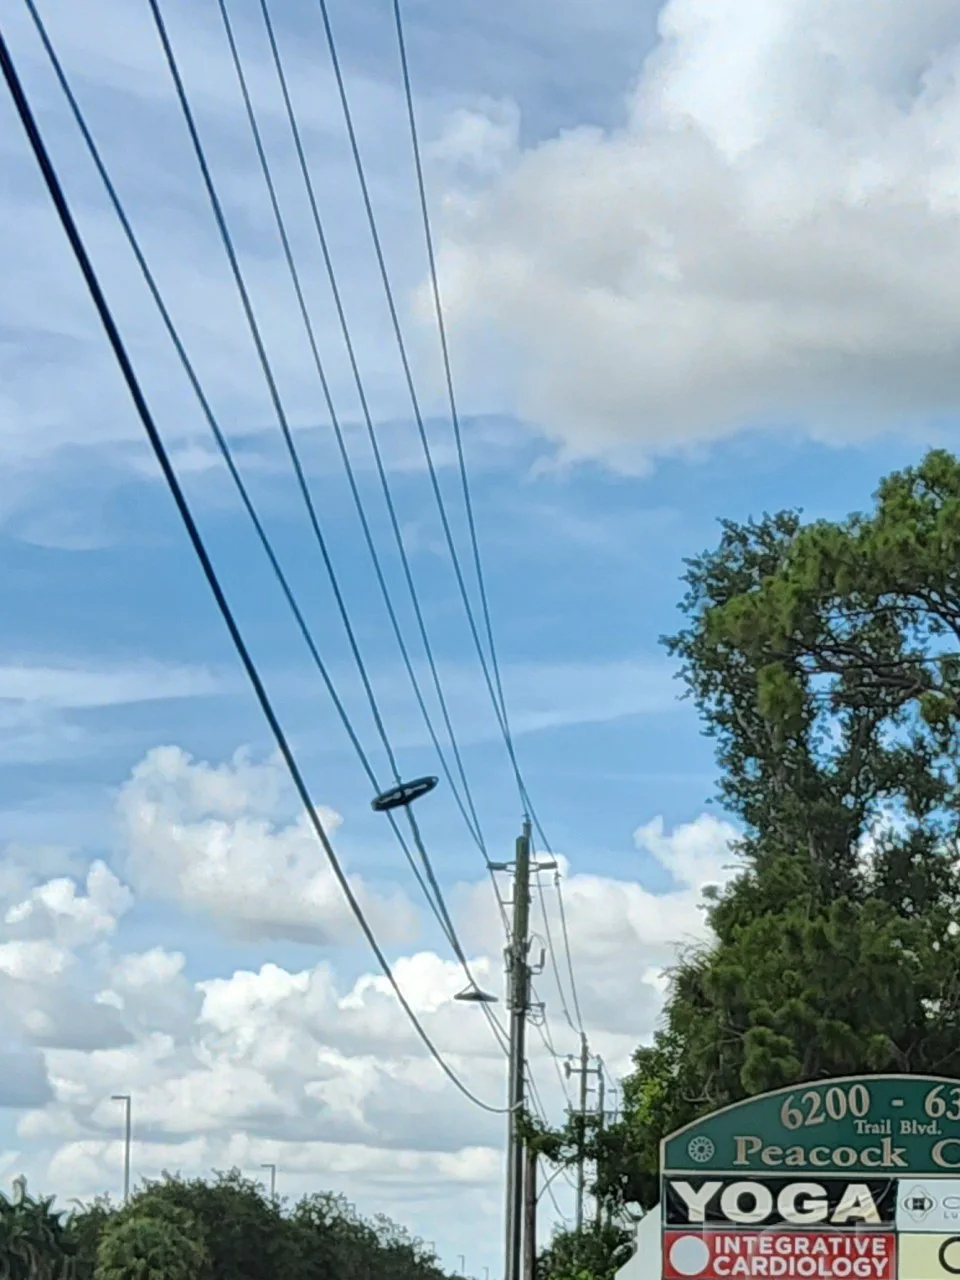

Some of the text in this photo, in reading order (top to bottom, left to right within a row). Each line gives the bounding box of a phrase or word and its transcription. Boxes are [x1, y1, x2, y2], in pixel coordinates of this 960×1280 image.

[780, 1083, 871, 1130] 6200
[853, 1119, 942, 1136] Trail Blvd.
[733, 1136, 907, 1167] Peacock
[669, 1181, 882, 1224] YOGA
[714, 1237, 886, 1254] INTEGRATIVE
[713, 1257, 889, 1277] CARDIOLOGY
